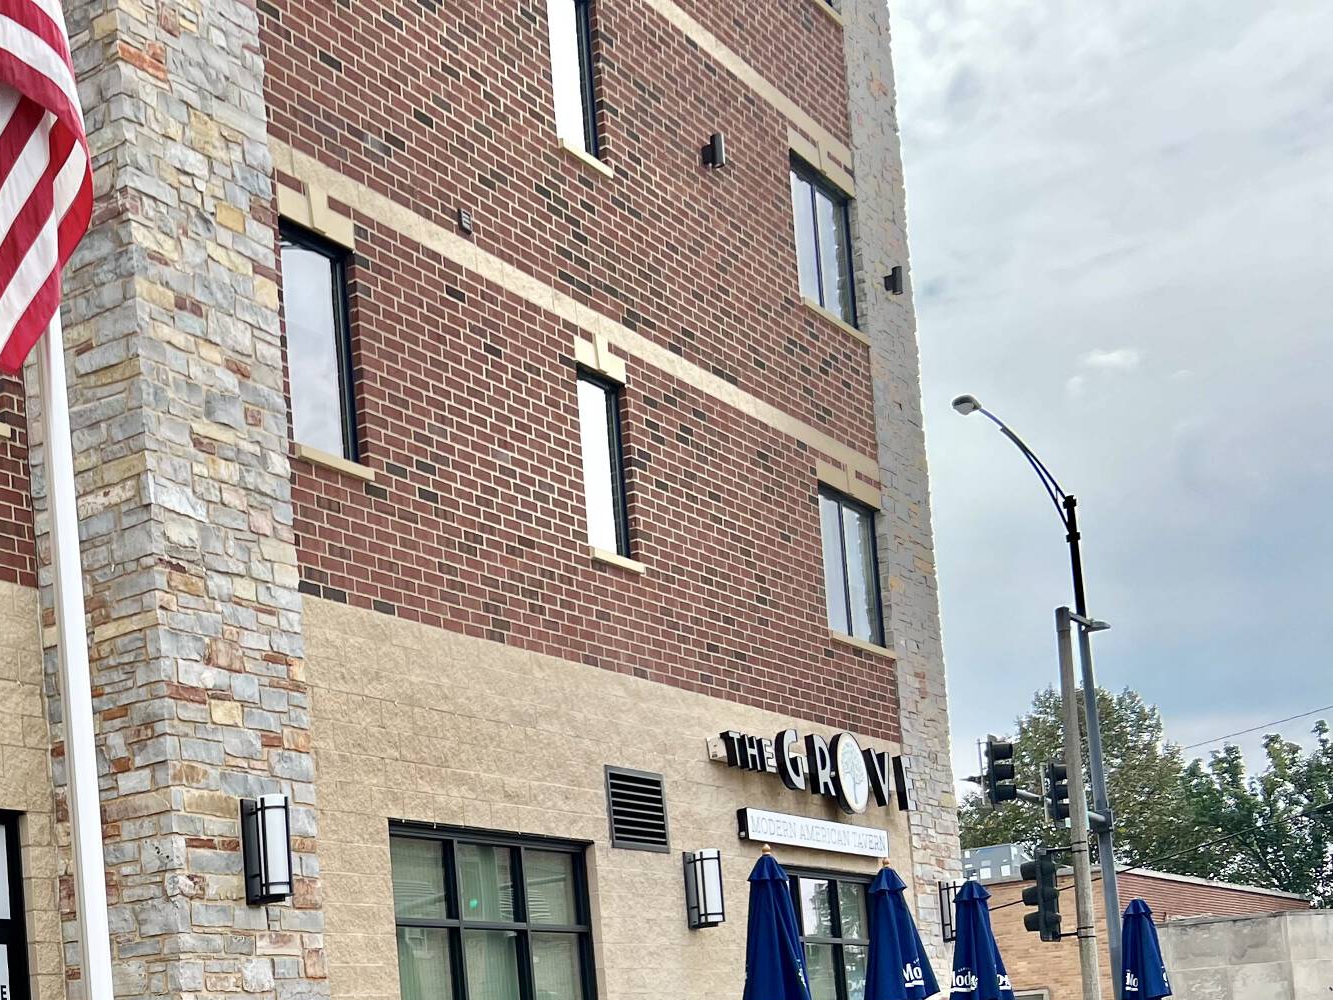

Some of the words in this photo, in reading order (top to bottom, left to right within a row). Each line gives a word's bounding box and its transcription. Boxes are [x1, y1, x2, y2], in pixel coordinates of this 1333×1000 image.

[721, 729, 778, 773] THE
[750, 815, 797, 838] MODERN
[799, 823, 850, 847] AMERICAN
[851, 831, 887, 852] TAVERN
